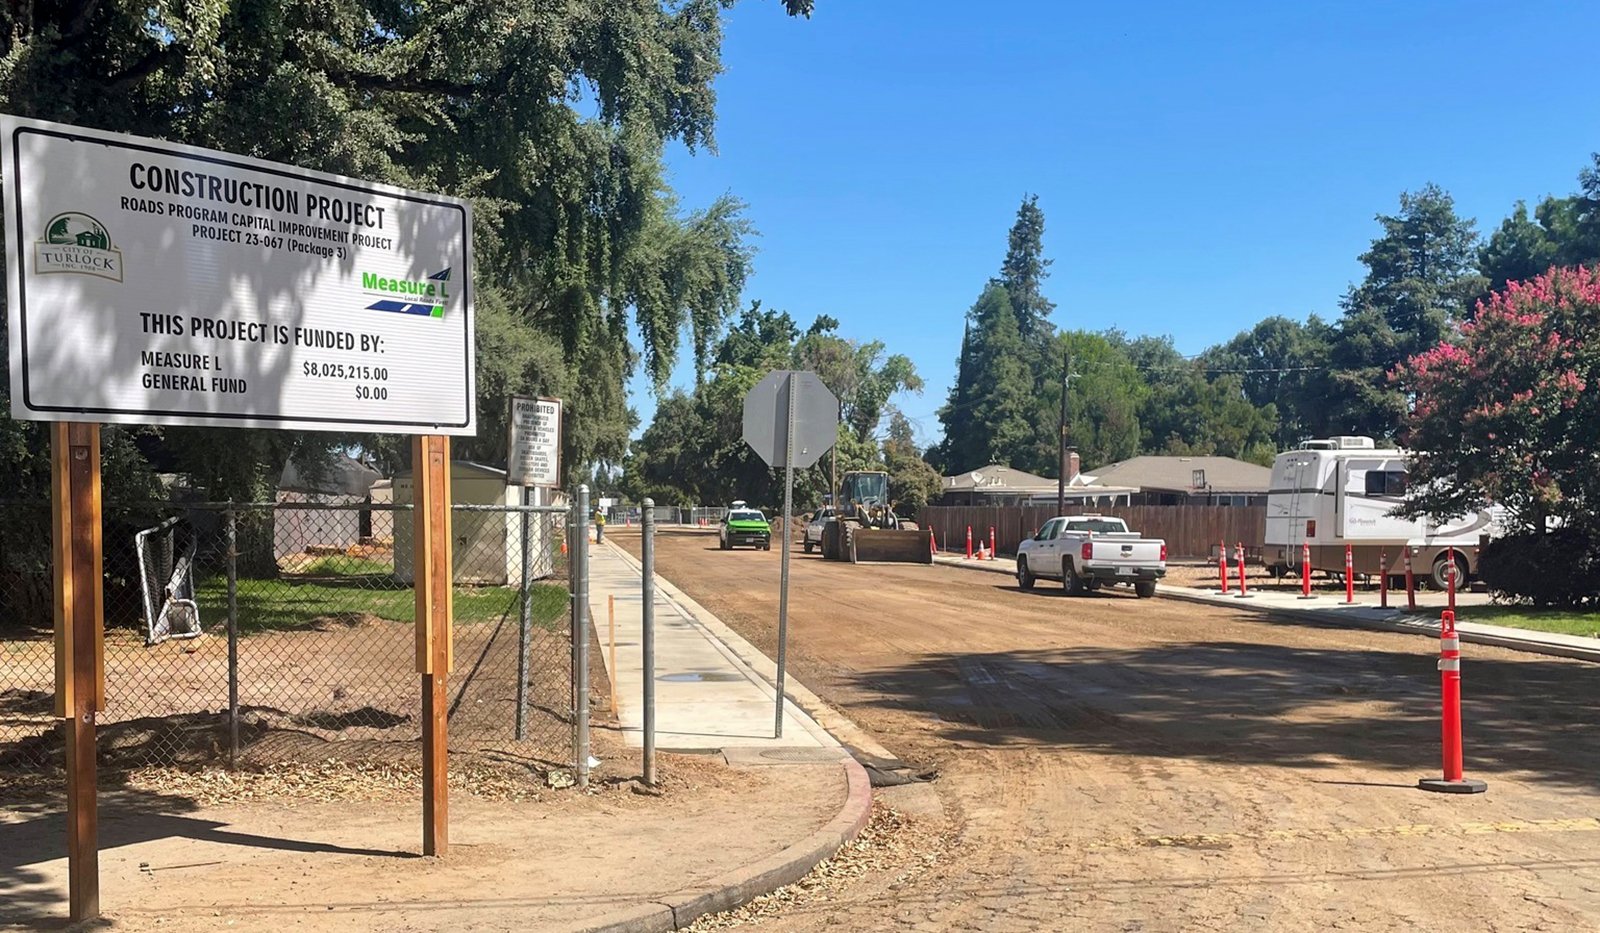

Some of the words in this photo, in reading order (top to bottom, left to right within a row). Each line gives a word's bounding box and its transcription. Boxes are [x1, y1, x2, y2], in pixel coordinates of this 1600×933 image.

[130, 163, 298, 215] CONSTRUCTION
[307, 193, 384, 229] PROJECT
[121, 196, 164, 215] ROADS
[169, 203, 228, 224] PROGRAM
[232, 213, 275, 232] CAPITAL
[279, 220, 349, 243] IMPROVEMENT
[353, 233, 392, 250] PROJECT
[62, 246, 80, 254] CITY
[193, 224, 241, 243] PROJECT
[245, 233, 283, 249] 23-067
[287, 238, 334, 259] (Package
[337, 247, 347, 260] 3)
[42, 252, 115, 271] TURLOCK
[362, 272, 436, 296] Measure
[441, 282, 449, 298] L
[140, 312, 184, 336] THIS
[191, 317, 267, 342] PROJECT
[274, 325, 289, 345] IS
[295, 327, 355, 350] FUNDED
[361, 334, 384, 353] BY:
[141, 351, 209, 370] MEASURE
[215, 356, 222, 371] L
[303, 360, 388, 380] $8,025,215.00
[142, 373, 207, 391] GENERAL
[212, 377, 247, 394] FUND
[355, 384, 388, 400] $0.00
[516, 402, 555, 414] PROHIBITED
